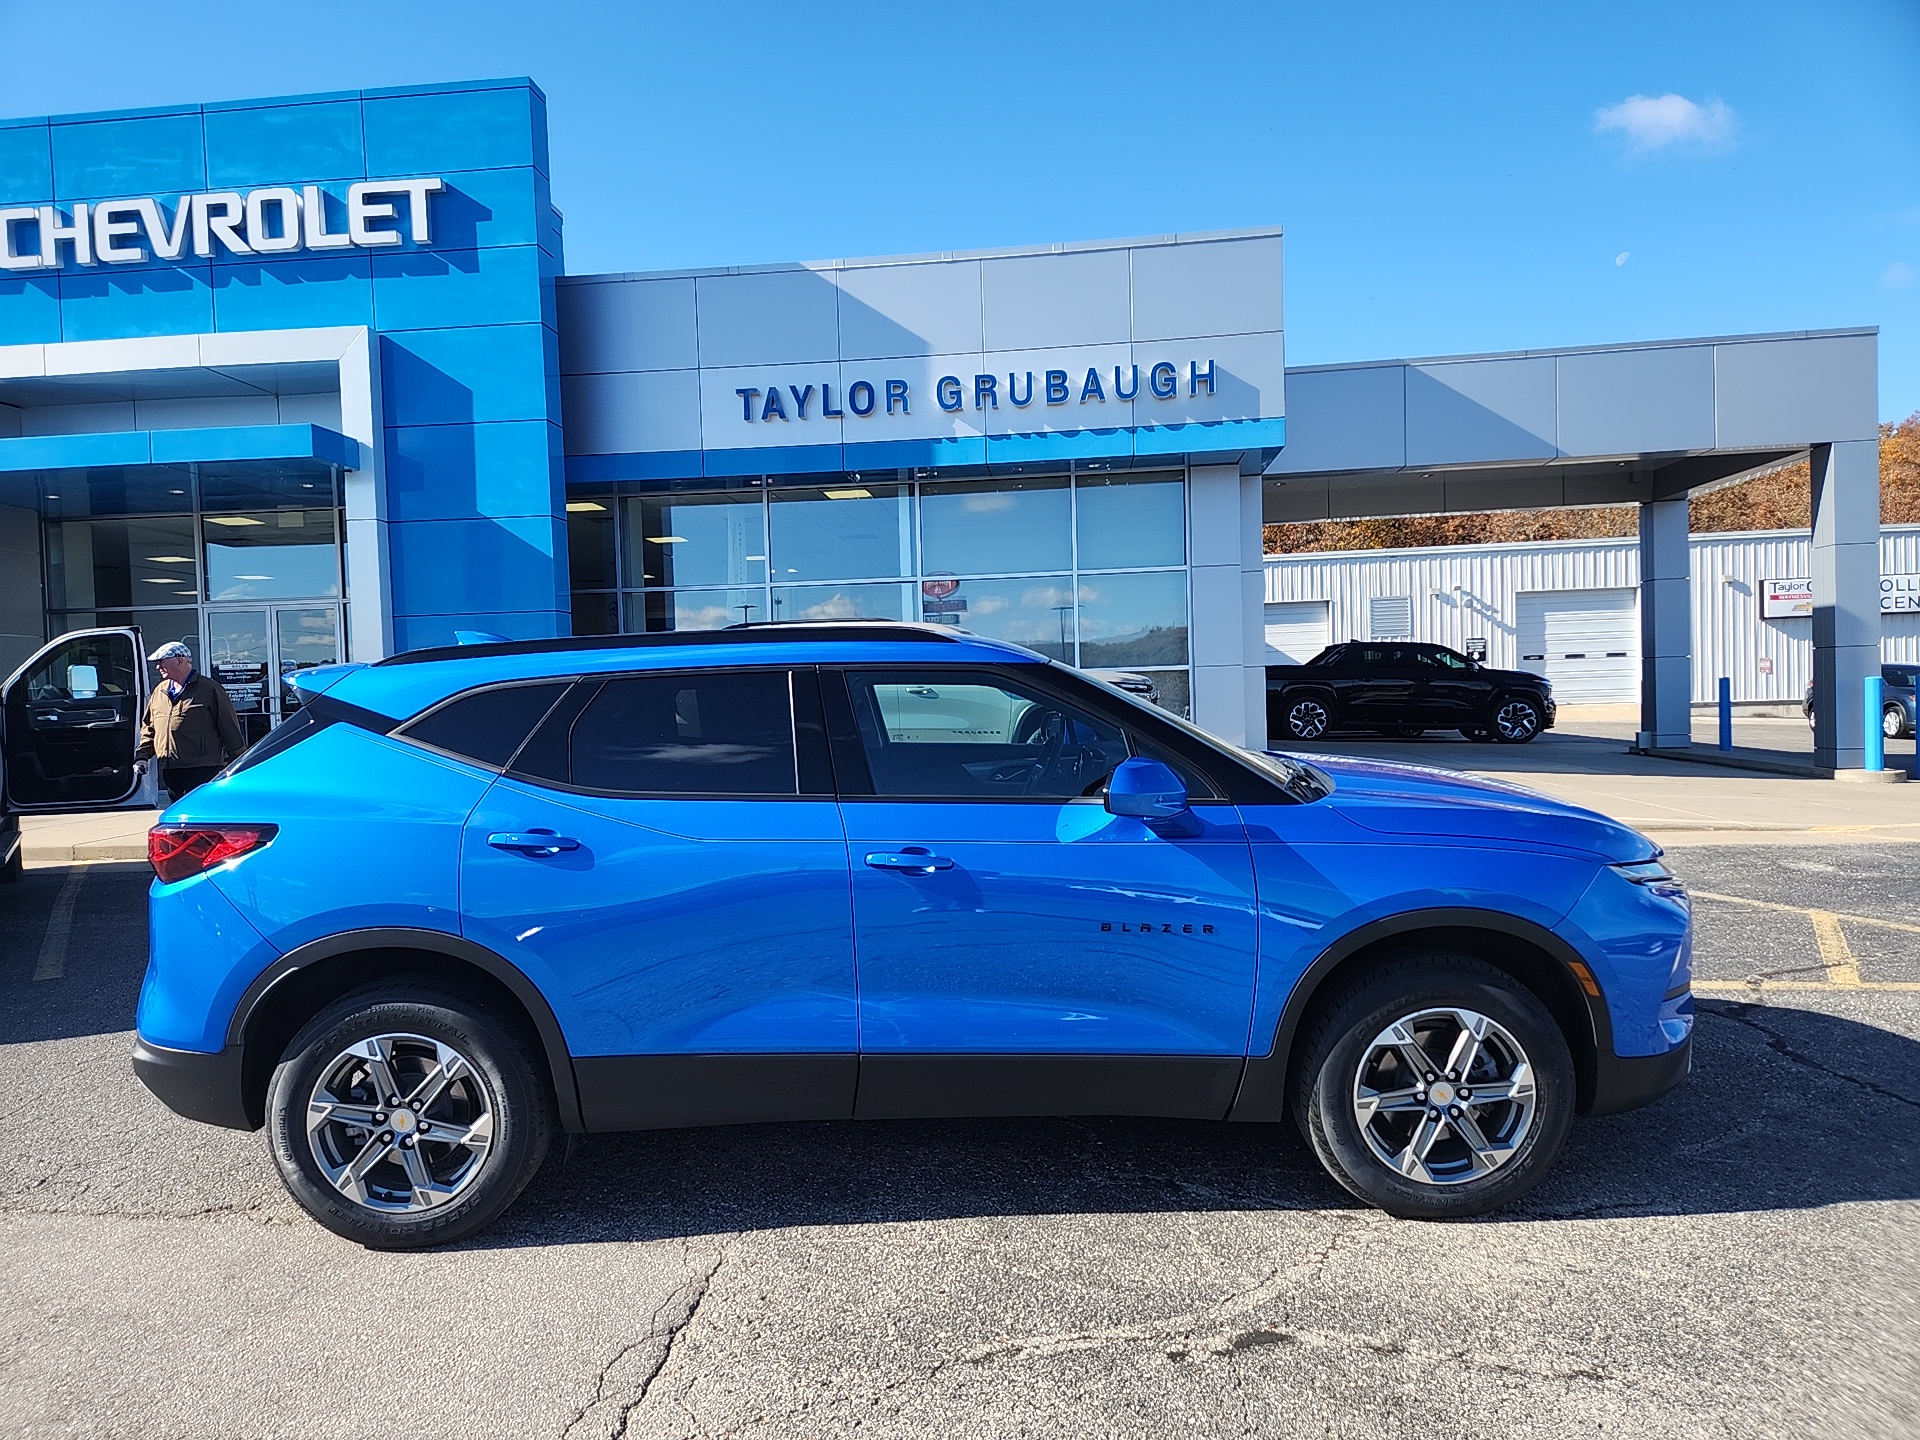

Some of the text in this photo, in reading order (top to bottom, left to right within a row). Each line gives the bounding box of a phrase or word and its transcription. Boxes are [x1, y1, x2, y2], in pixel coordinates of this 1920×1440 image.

[0, 177, 444, 271] CHEVROLET
[735, 359, 1218, 422] TAYLOR GRUBAUGH
[1769, 582, 1804, 593] Taylor
[1880, 579, 1920, 592] OLL
[1100, 923, 1214, 934] BLAZER
